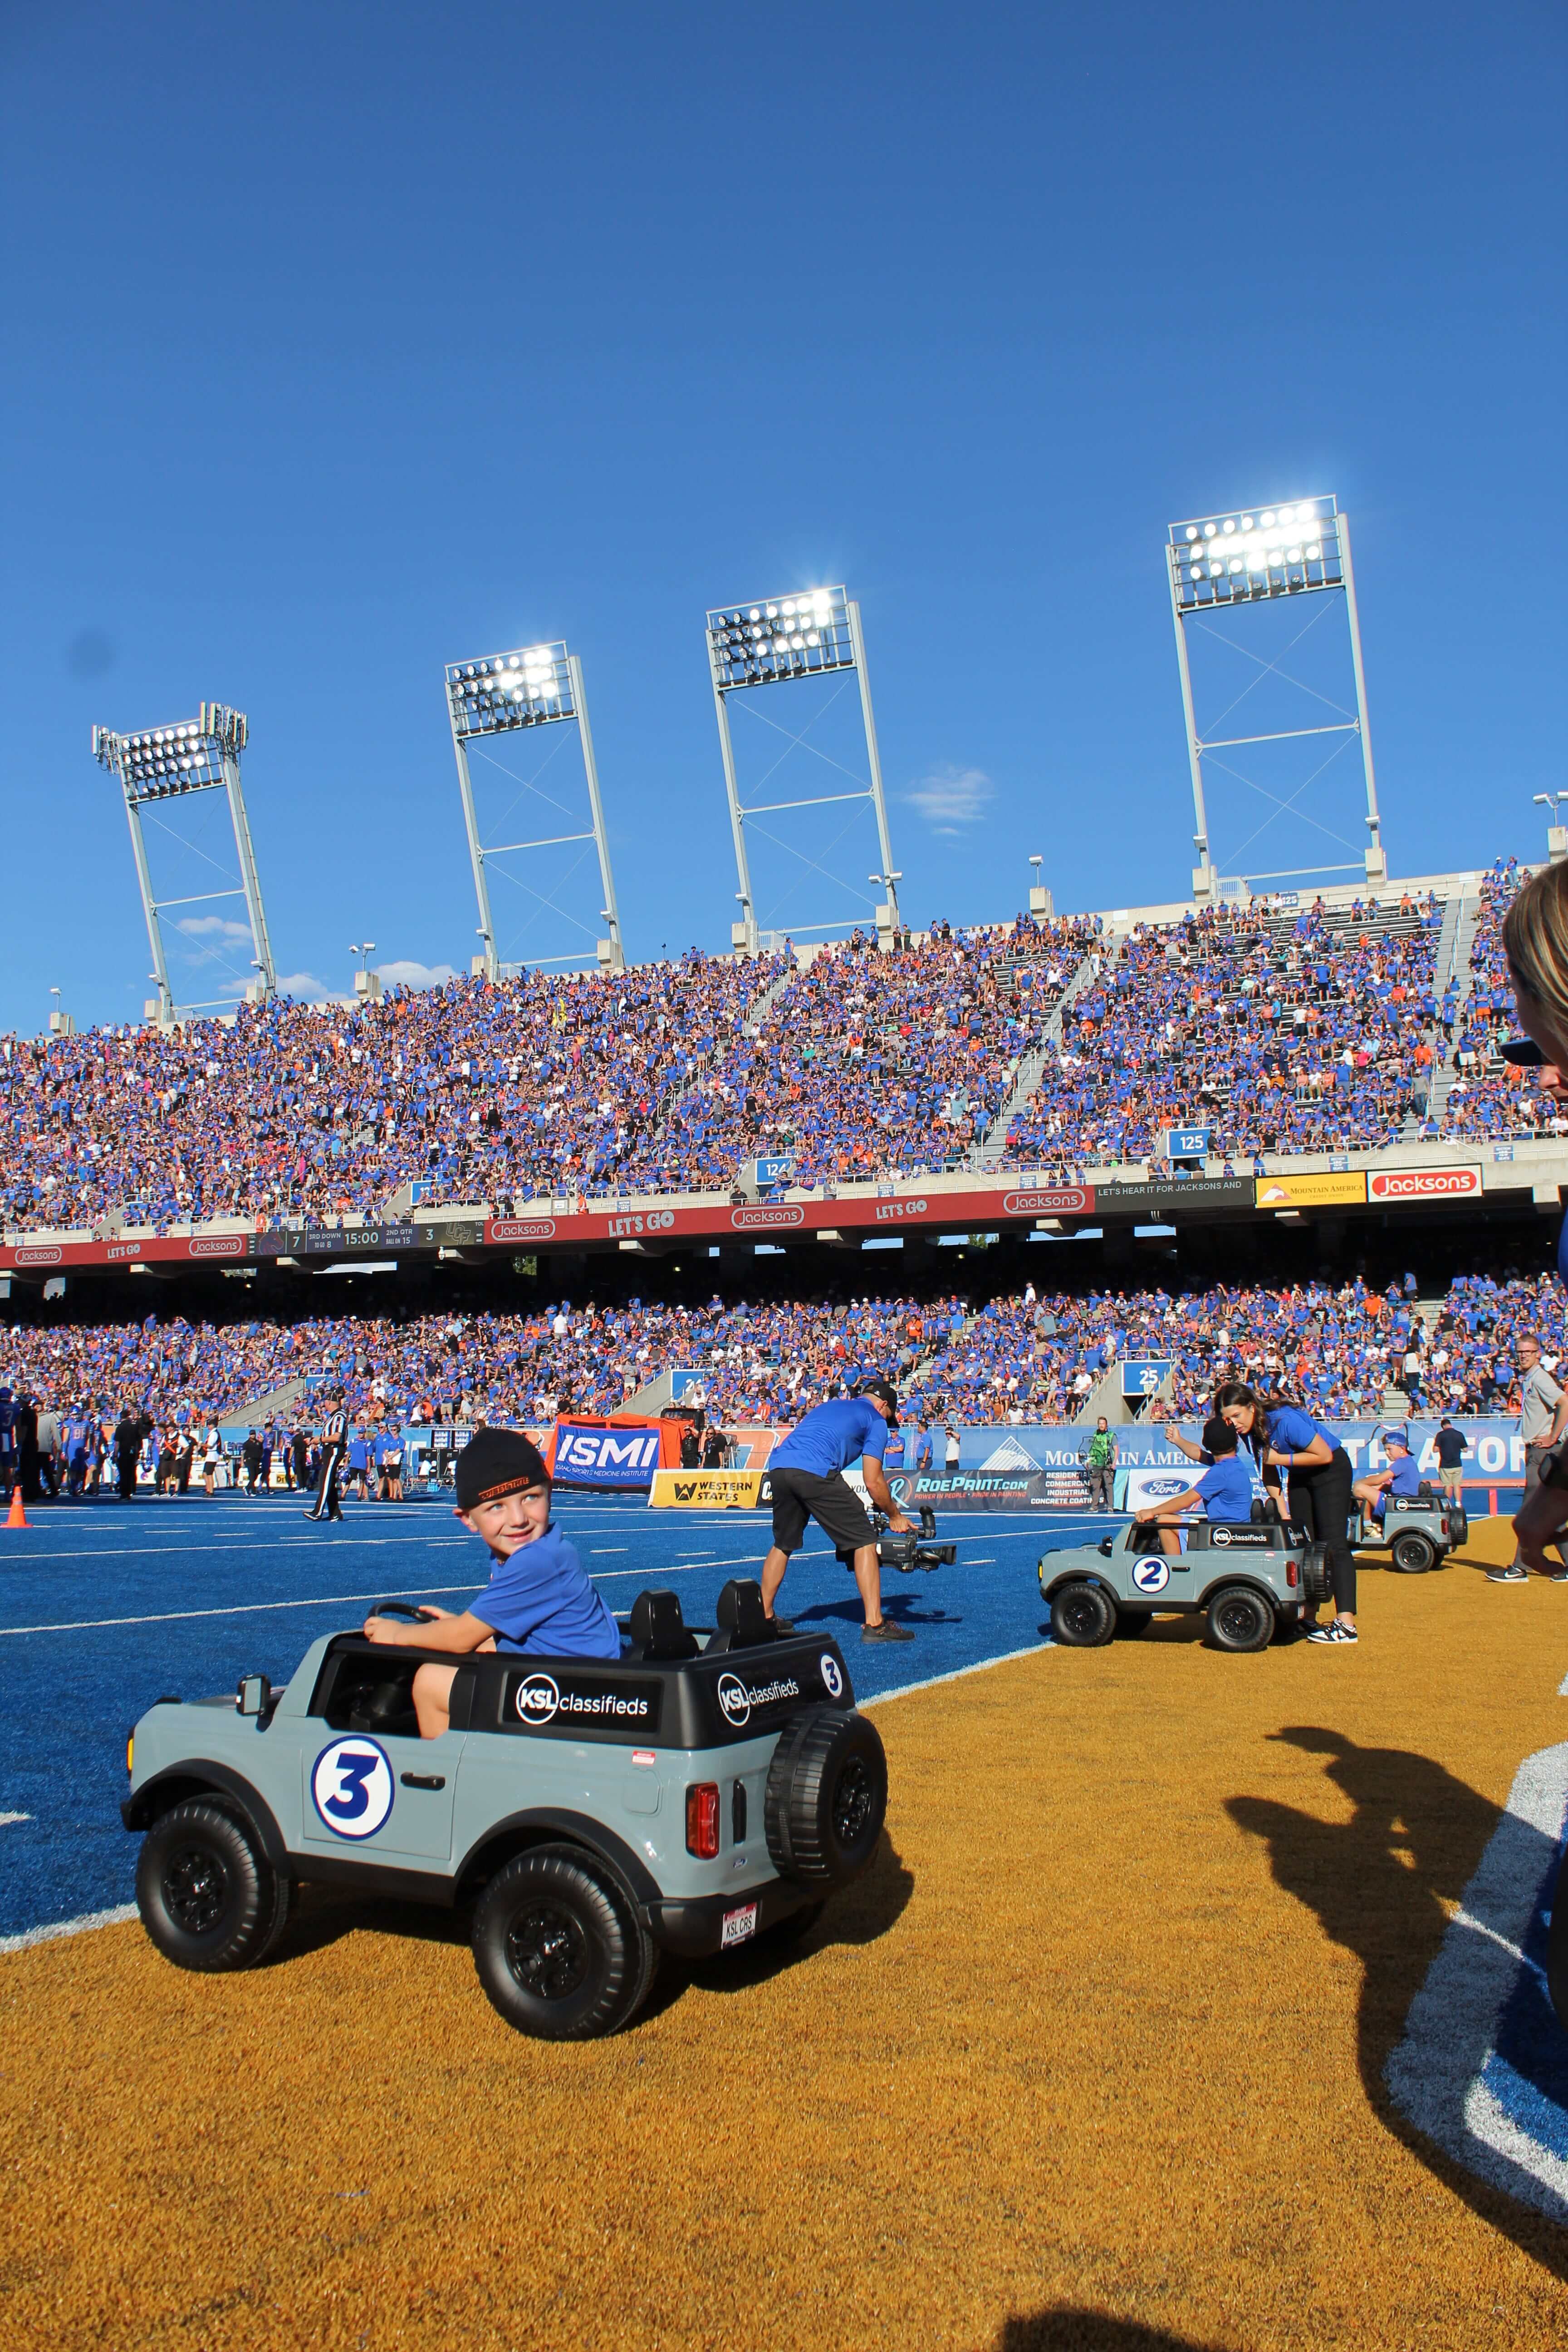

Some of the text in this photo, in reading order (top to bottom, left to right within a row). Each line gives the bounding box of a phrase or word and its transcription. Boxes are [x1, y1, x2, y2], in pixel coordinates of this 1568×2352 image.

[1282, 896, 1297, 905] 125
[1180, 1135, 1204, 1150] 125
[1098, 1181, 1242, 1196] LET'S HEAR IT FOR JACKSONS AND
[1290, 1186, 1329, 1195] MOUNTAIN
[1379, 1174, 1471, 1196] Jacksons
[875, 1199, 927, 1220] LET'S GO
[1012, 1195, 1078, 1210] Jacksons
[608, 1210, 675, 1238] LET'S GO
[739, 1210, 797, 1225] Jacksons
[321, 1231, 341, 1240] DOWN
[345, 1232, 379, 1245] 15:00
[426, 1229, 434, 1241] 3
[498, 1224, 549, 1238] Jacksons
[194, 1241, 237, 1254] Jacksons
[292, 1236, 299, 1248] 7
[402, 1236, 411, 1245] 15
[20, 1250, 58, 1262] Jacksons
[107, 1244, 141, 1259] LET'S GO
[1139, 1369, 1159, 1385] 25
[557, 1434, 658, 1467] ISMI
[700, 1481, 752, 1491] WESTERN
[1149, 1480, 1181, 1494] Ford
[697, 1492, 738, 1502] STATES
[1215, 1533, 1267, 1542] KSL classifieds
[1140, 1561, 1161, 1584] 2
[825, 1661, 839, 1691] 3
[520, 1688, 648, 1715] KSL classifieds
[721, 1678, 799, 1712] KSL classifieds
[324, 1752, 379, 1820] 3
[726, 1914, 752, 1938] KSL CRS
